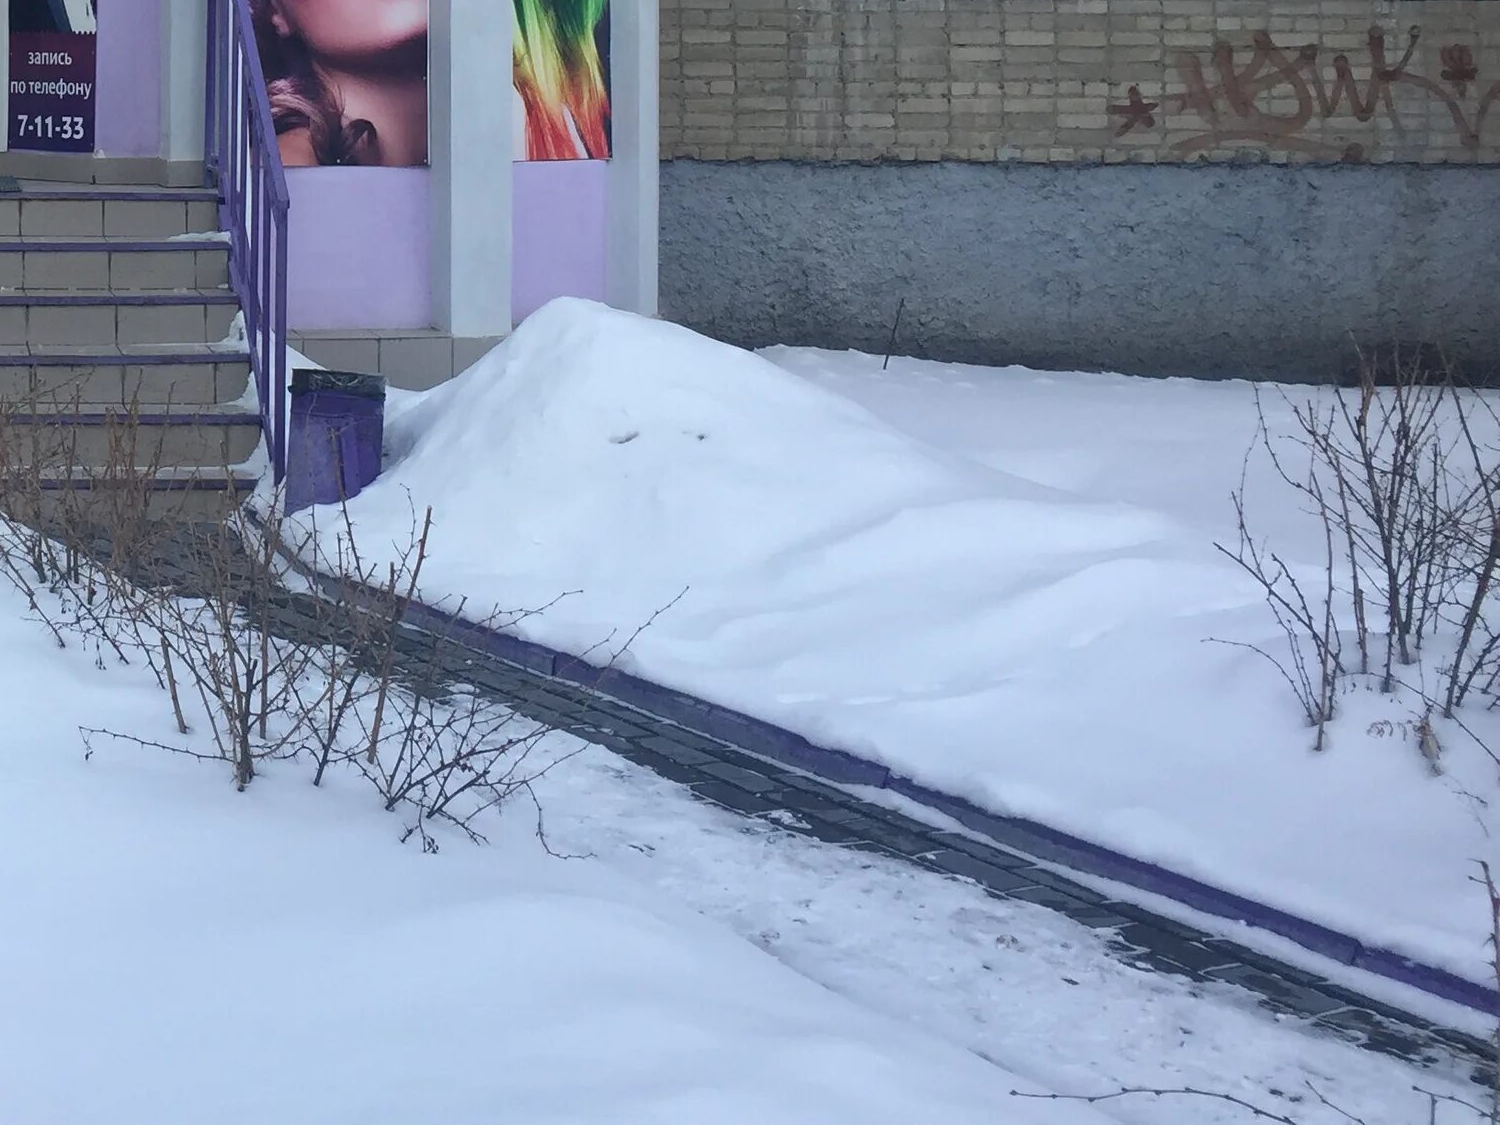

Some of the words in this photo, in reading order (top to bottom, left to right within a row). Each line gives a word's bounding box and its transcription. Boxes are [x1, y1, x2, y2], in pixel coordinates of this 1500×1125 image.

[27, 51, 73, 66] запись
[10, 80, 26, 94] по
[28, 77, 92, 100] телефону
[17, 114, 84, 140] 7-11-33
